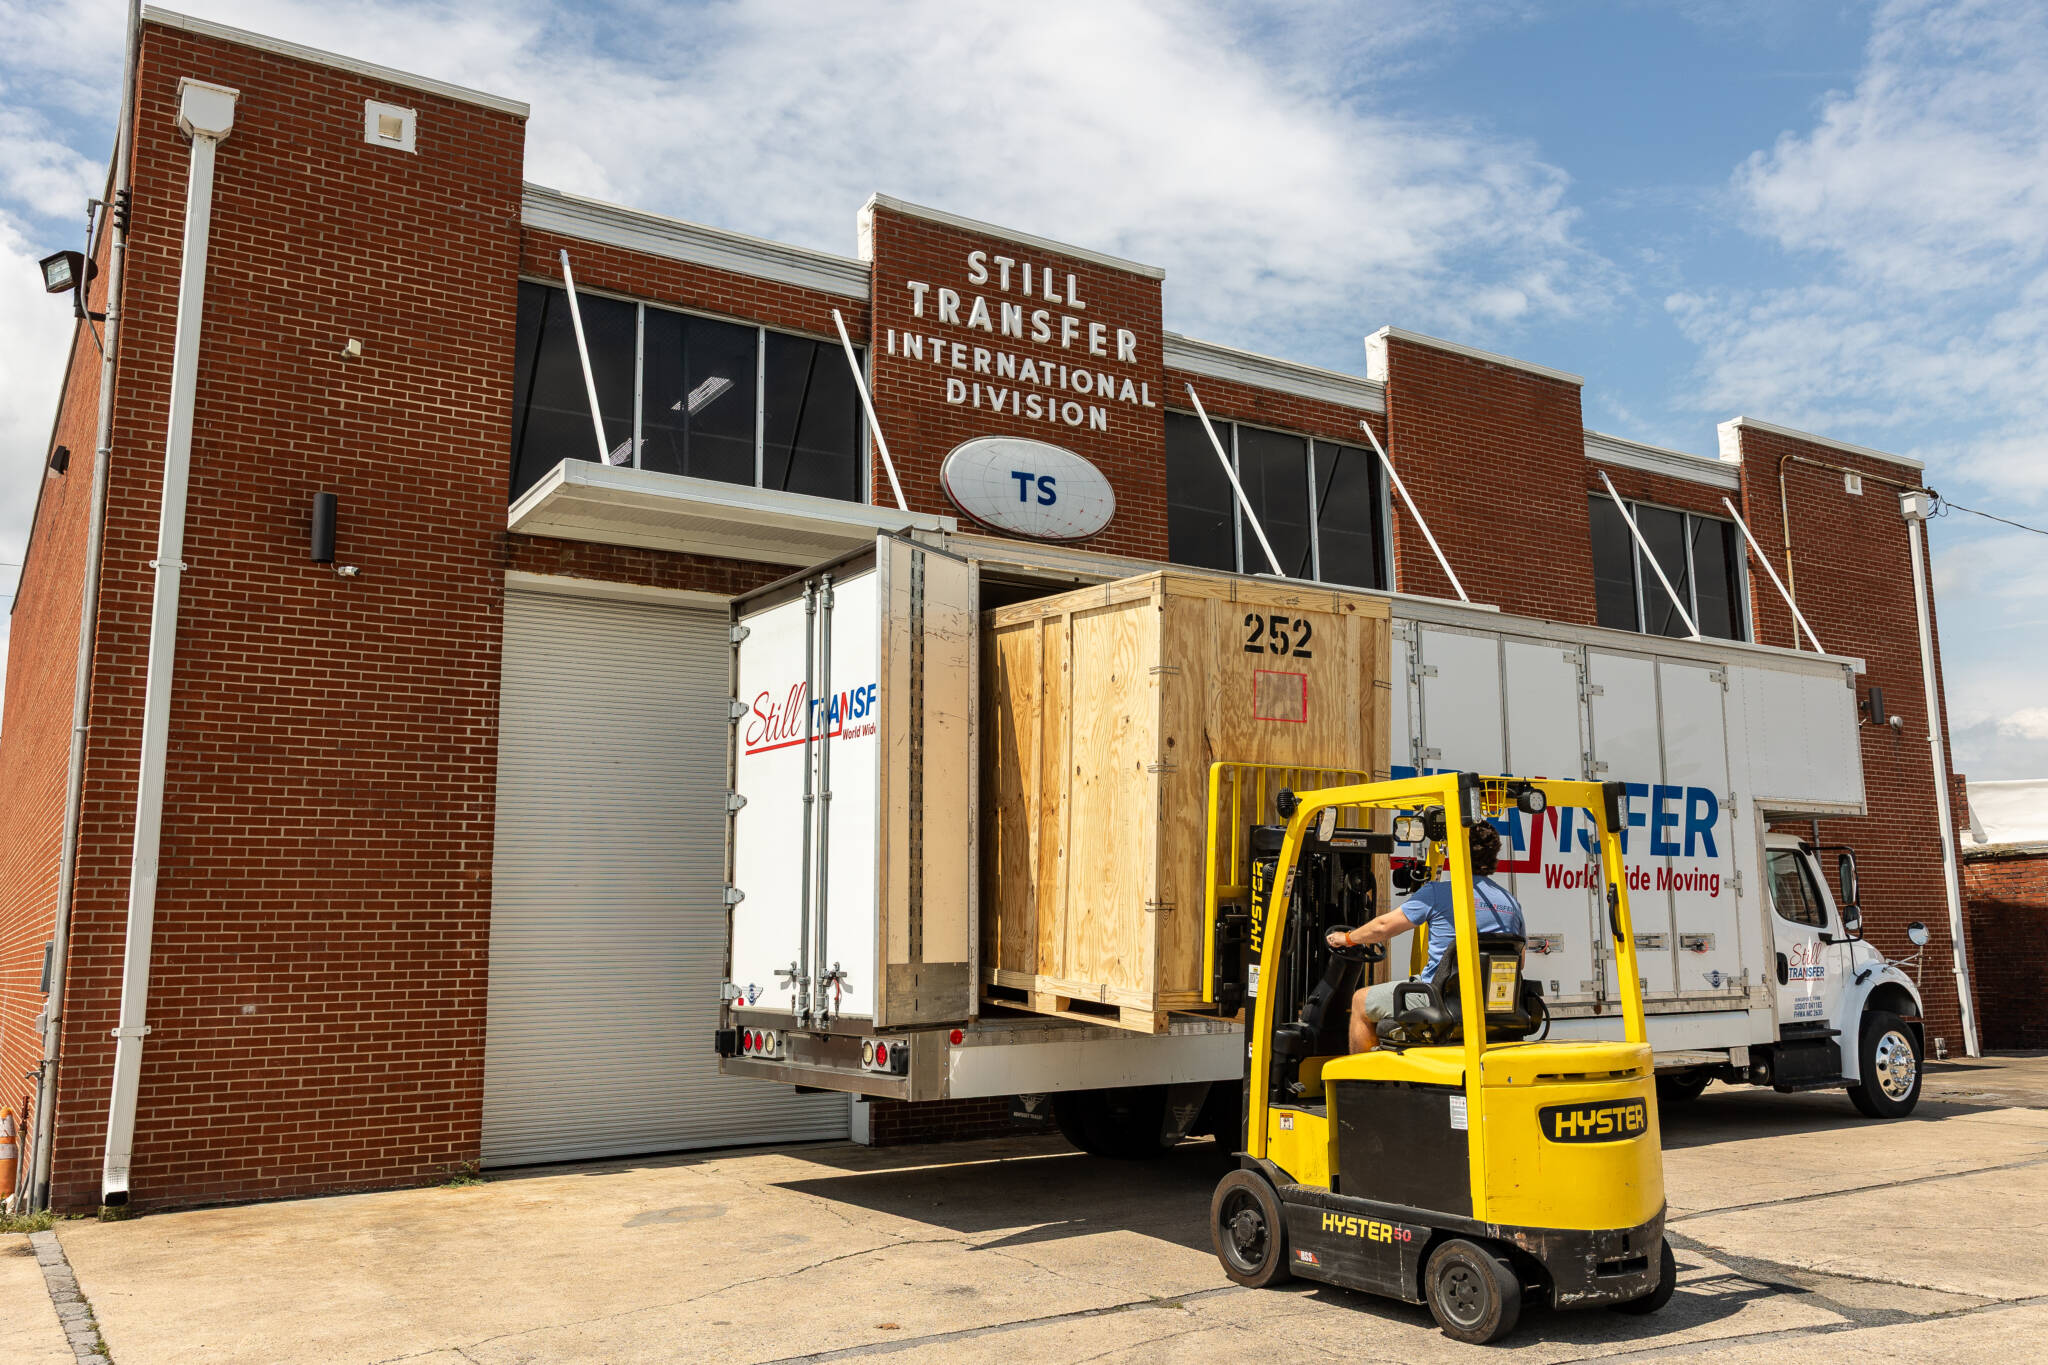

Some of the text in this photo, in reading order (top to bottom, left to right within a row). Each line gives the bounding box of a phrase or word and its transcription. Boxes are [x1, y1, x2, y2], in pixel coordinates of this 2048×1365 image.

[967, 250, 1086, 310] STILL
[906, 280, 1138, 364] TRANSFER
[887, 329, 1156, 408] INTERNATIONAL
[946, 378, 1108, 432] DIVISION
[1011, 470, 1057, 506] TS
[1243, 613, 1313, 659] 252
[745, 681, 807, 747] Still
[842, 726, 861, 741] World
[1391, 765, 1719, 858] TANFER
[1656, 867, 1720, 898] Moving
[1250, 861, 1264, 953] HYSTER
[1788, 966, 1825, 978] TRANSFER
[1790, 942, 1822, 967] Still
[1555, 1104, 1644, 1138] HYSTER
[1322, 1212, 1412, 1244] HYSTER 50
